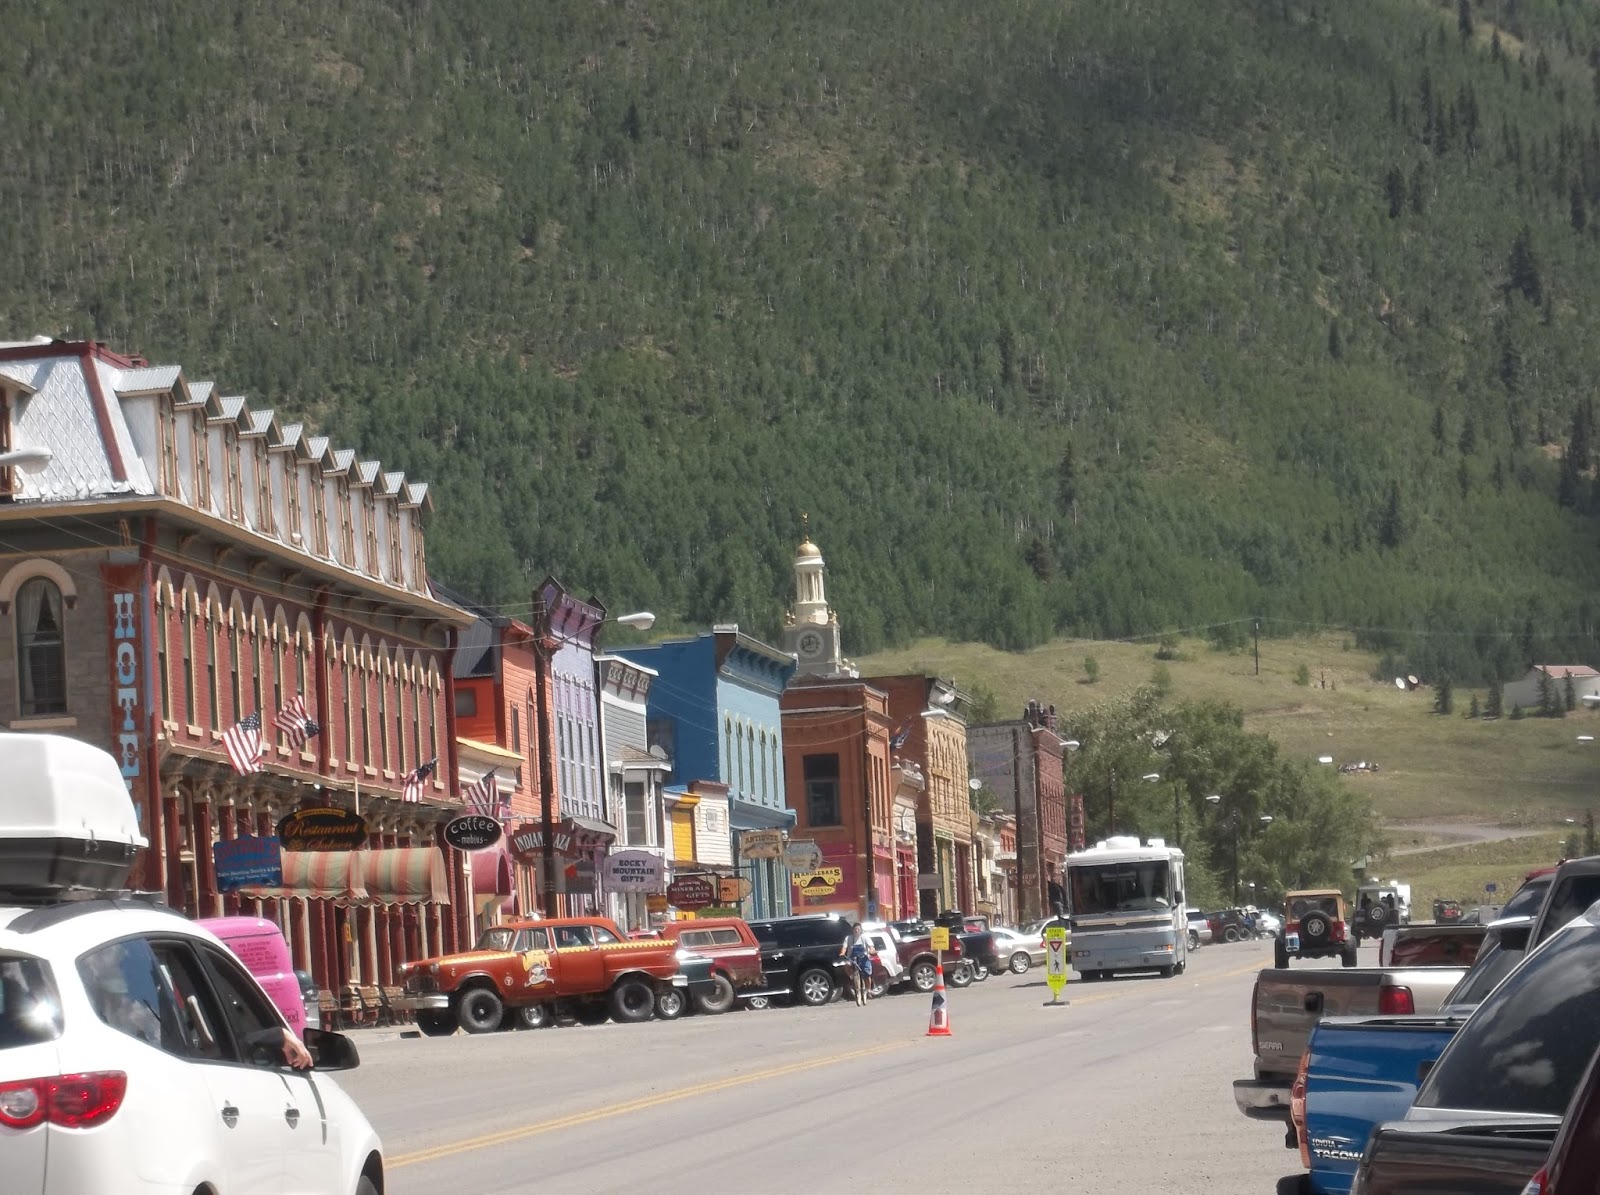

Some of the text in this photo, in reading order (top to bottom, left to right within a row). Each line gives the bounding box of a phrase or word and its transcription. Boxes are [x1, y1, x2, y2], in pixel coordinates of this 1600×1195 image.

[286, 820, 358, 837] Restaurant
[450, 817, 494, 834] coffee
[513, 831, 571, 853] INDIAN AZA
[618, 859, 647, 867] ROCKY
[794, 868, 840, 879] HANDLEBARS
[1258, 1041, 1283, 1050] SIERRA
[1312, 1138, 1336, 1148] TOYOTA
